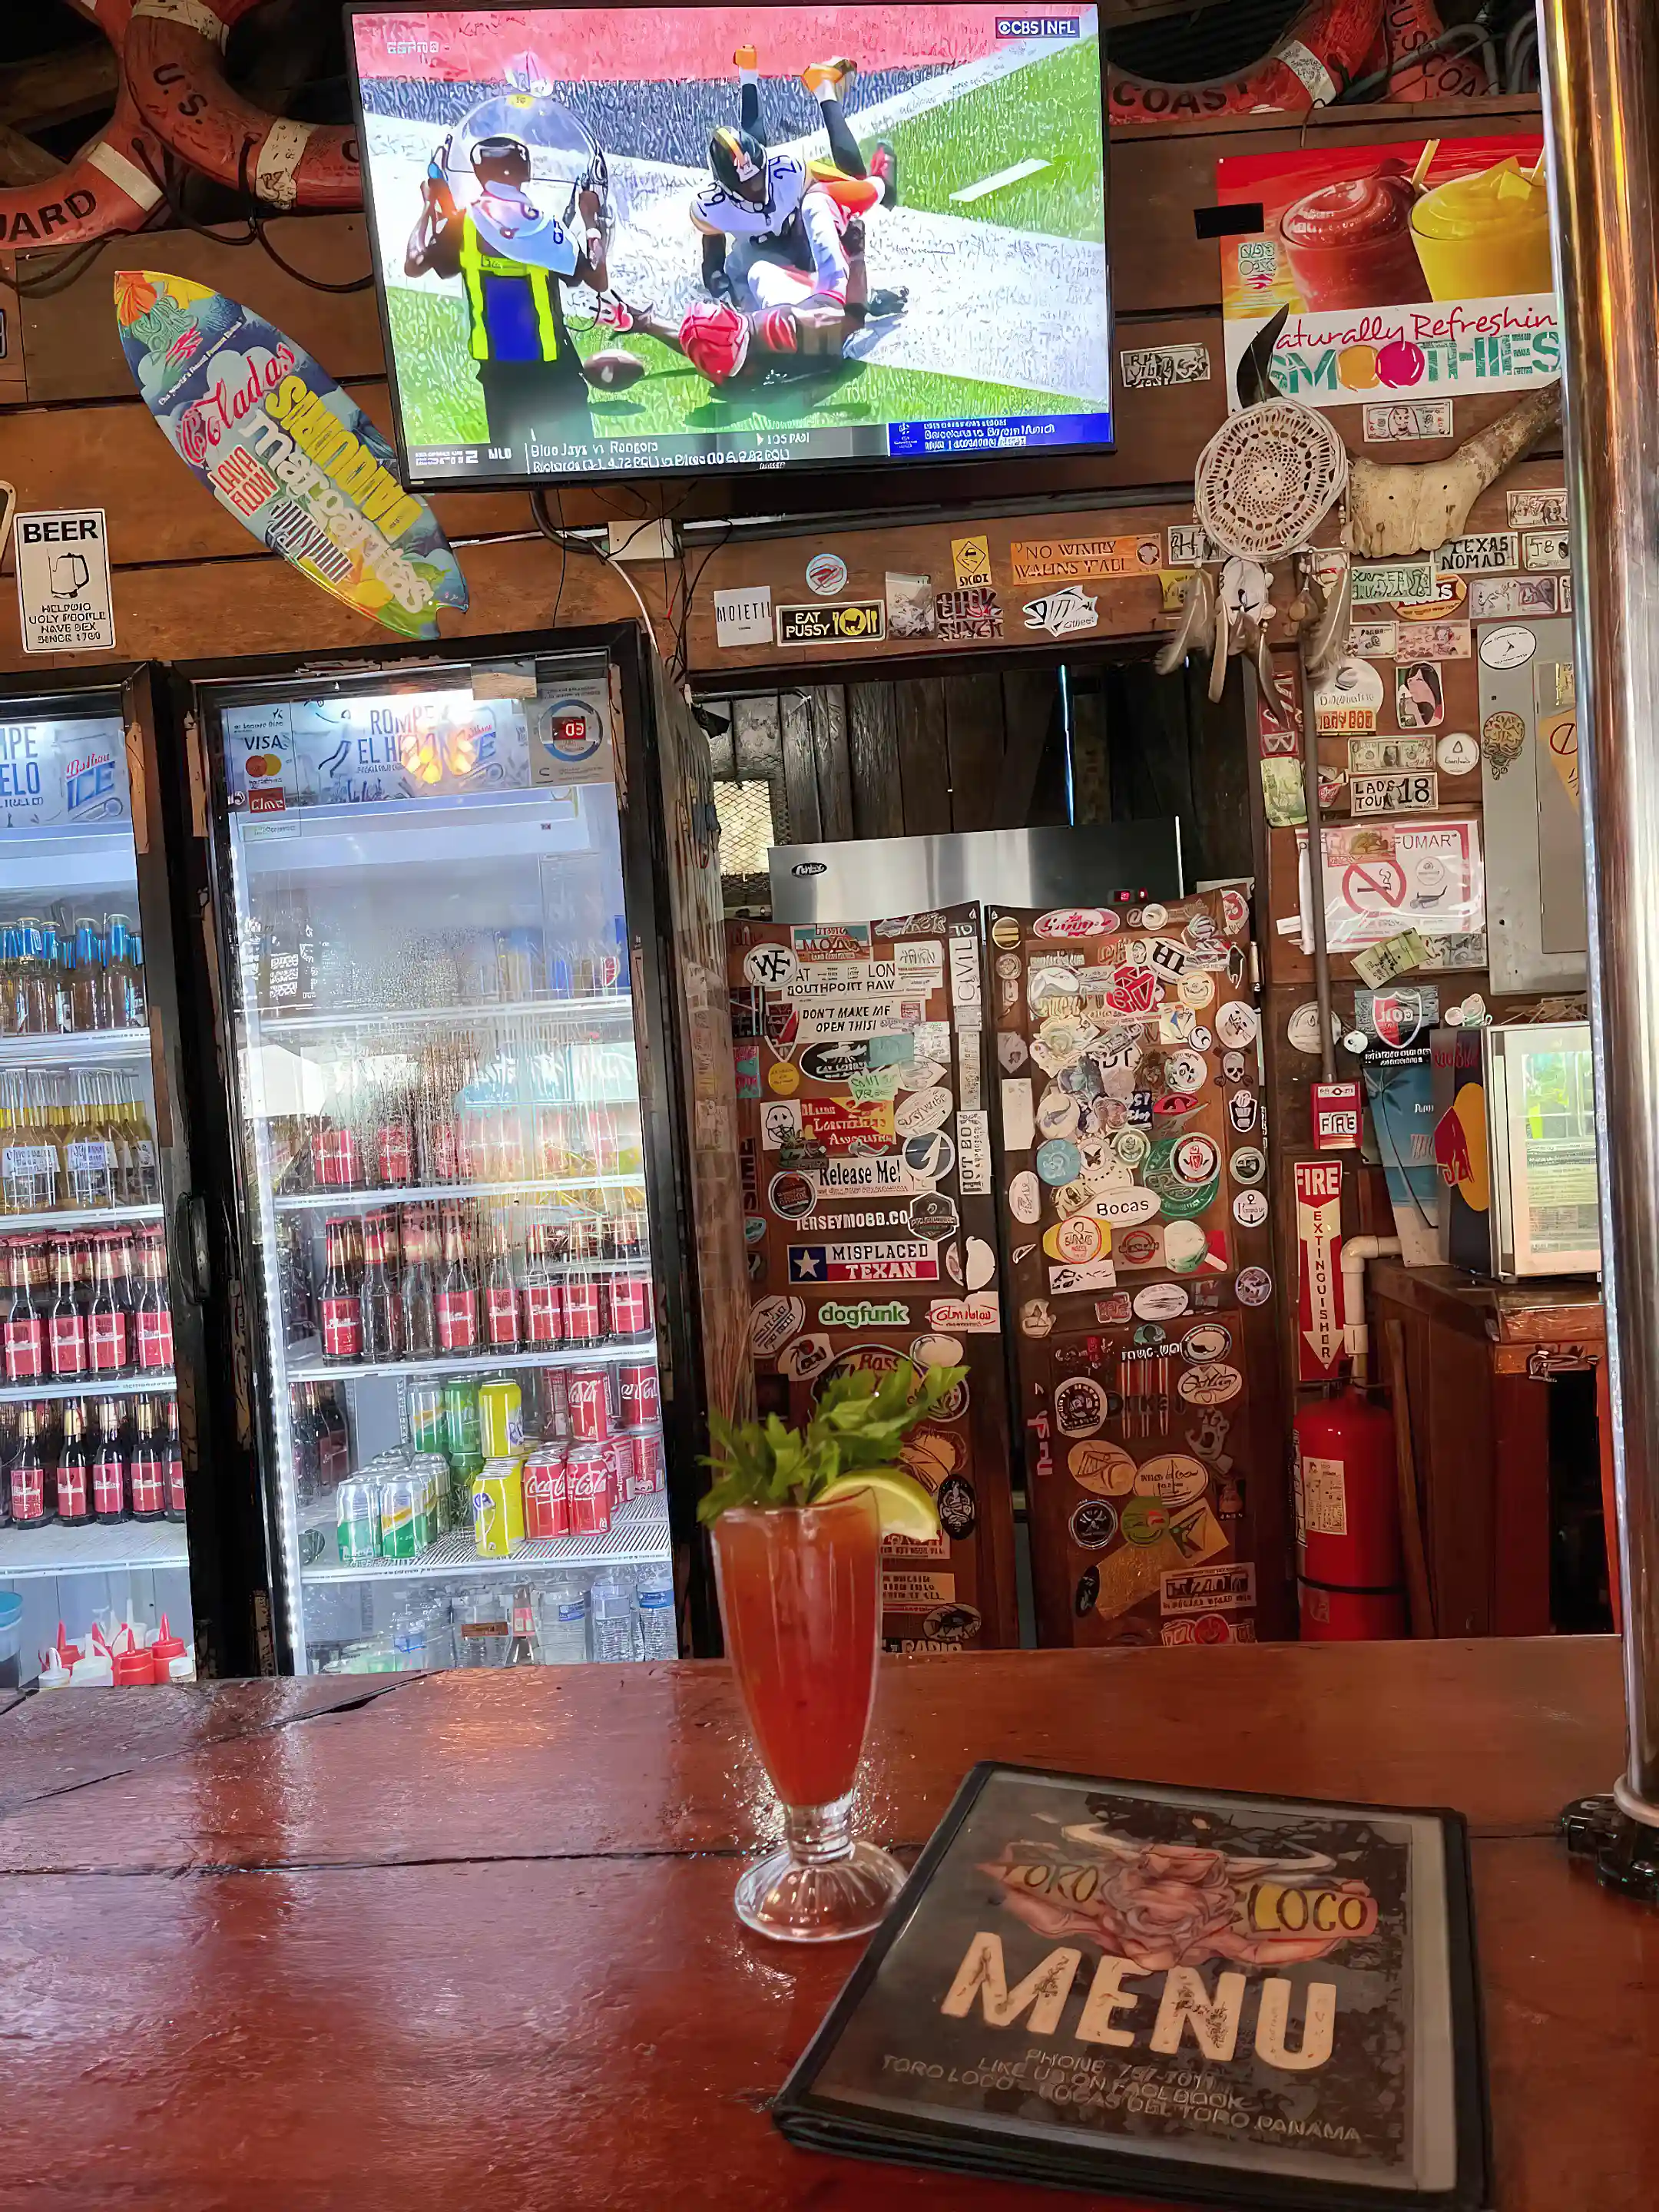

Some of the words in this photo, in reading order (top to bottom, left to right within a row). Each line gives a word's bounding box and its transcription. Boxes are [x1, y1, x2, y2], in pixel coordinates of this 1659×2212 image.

[1011, 21, 1039, 35] CBS
[1047, 20, 1076, 34] NFL
[1275, 316, 1405, 351] aturally
[1411, 306, 1558, 341] Refreshin
[23, 519, 98, 544] BEER
[1441, 552, 1506, 571] NOMAD
[795, 612, 820, 624] EAT
[786, 624, 830, 637] PUSSY
[244, 734, 286, 750] VISA
[1398, 778, 1430, 803] 18
[803, 1008, 834, 1020] DON'T
[838, 1006, 869, 1018] MAKE
[816, 1022, 845, 1032] OPEN
[820, 1162, 873, 1186] Release
[876, 1159, 902, 1184] Me!
[1296, 1167, 1340, 1196] FIRE
[1097, 1200, 1149, 1216] Bocas
[833, 1243, 928, 1260] MISPLACED
[846, 1262, 917, 1280] TEXAN
[821, 1305, 907, 1325] dogfunk
[1247, 1883, 1369, 1932] LOCO
[941, 1931, 1337, 2070] MENU
[1072, 2071, 1107, 2091] ON
[882, 2054, 943, 2079] TORO
[948, 2067, 1015, 2091] LOCO
[1178, 2103, 1250, 2129] TORO
